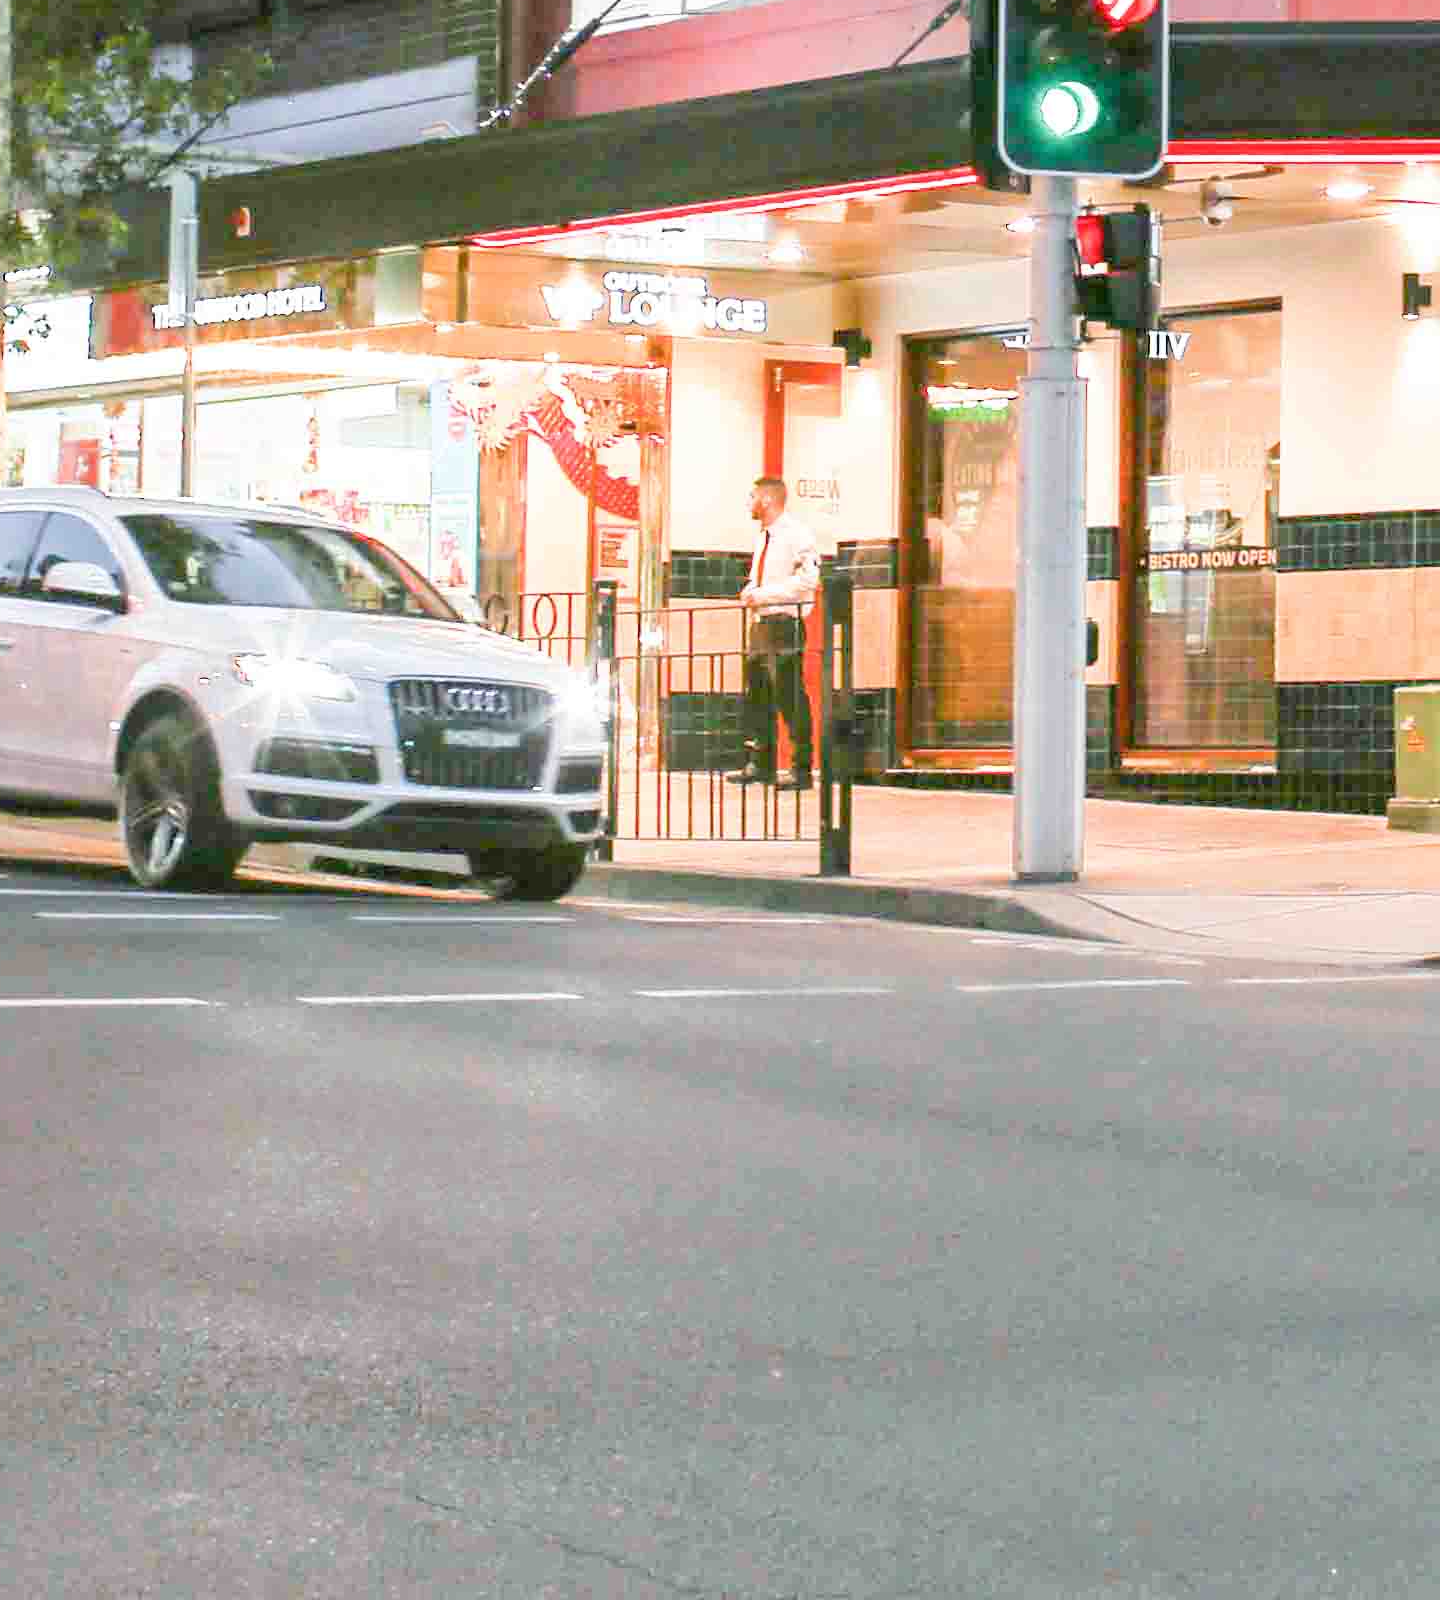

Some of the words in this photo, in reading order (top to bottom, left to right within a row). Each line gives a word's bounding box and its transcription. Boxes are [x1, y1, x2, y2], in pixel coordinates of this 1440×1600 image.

[1149, 552, 1199, 570] BISTRO
[1201, 551, 1236, 569] NOW
[1238, 548, 1278, 566] OPEN
